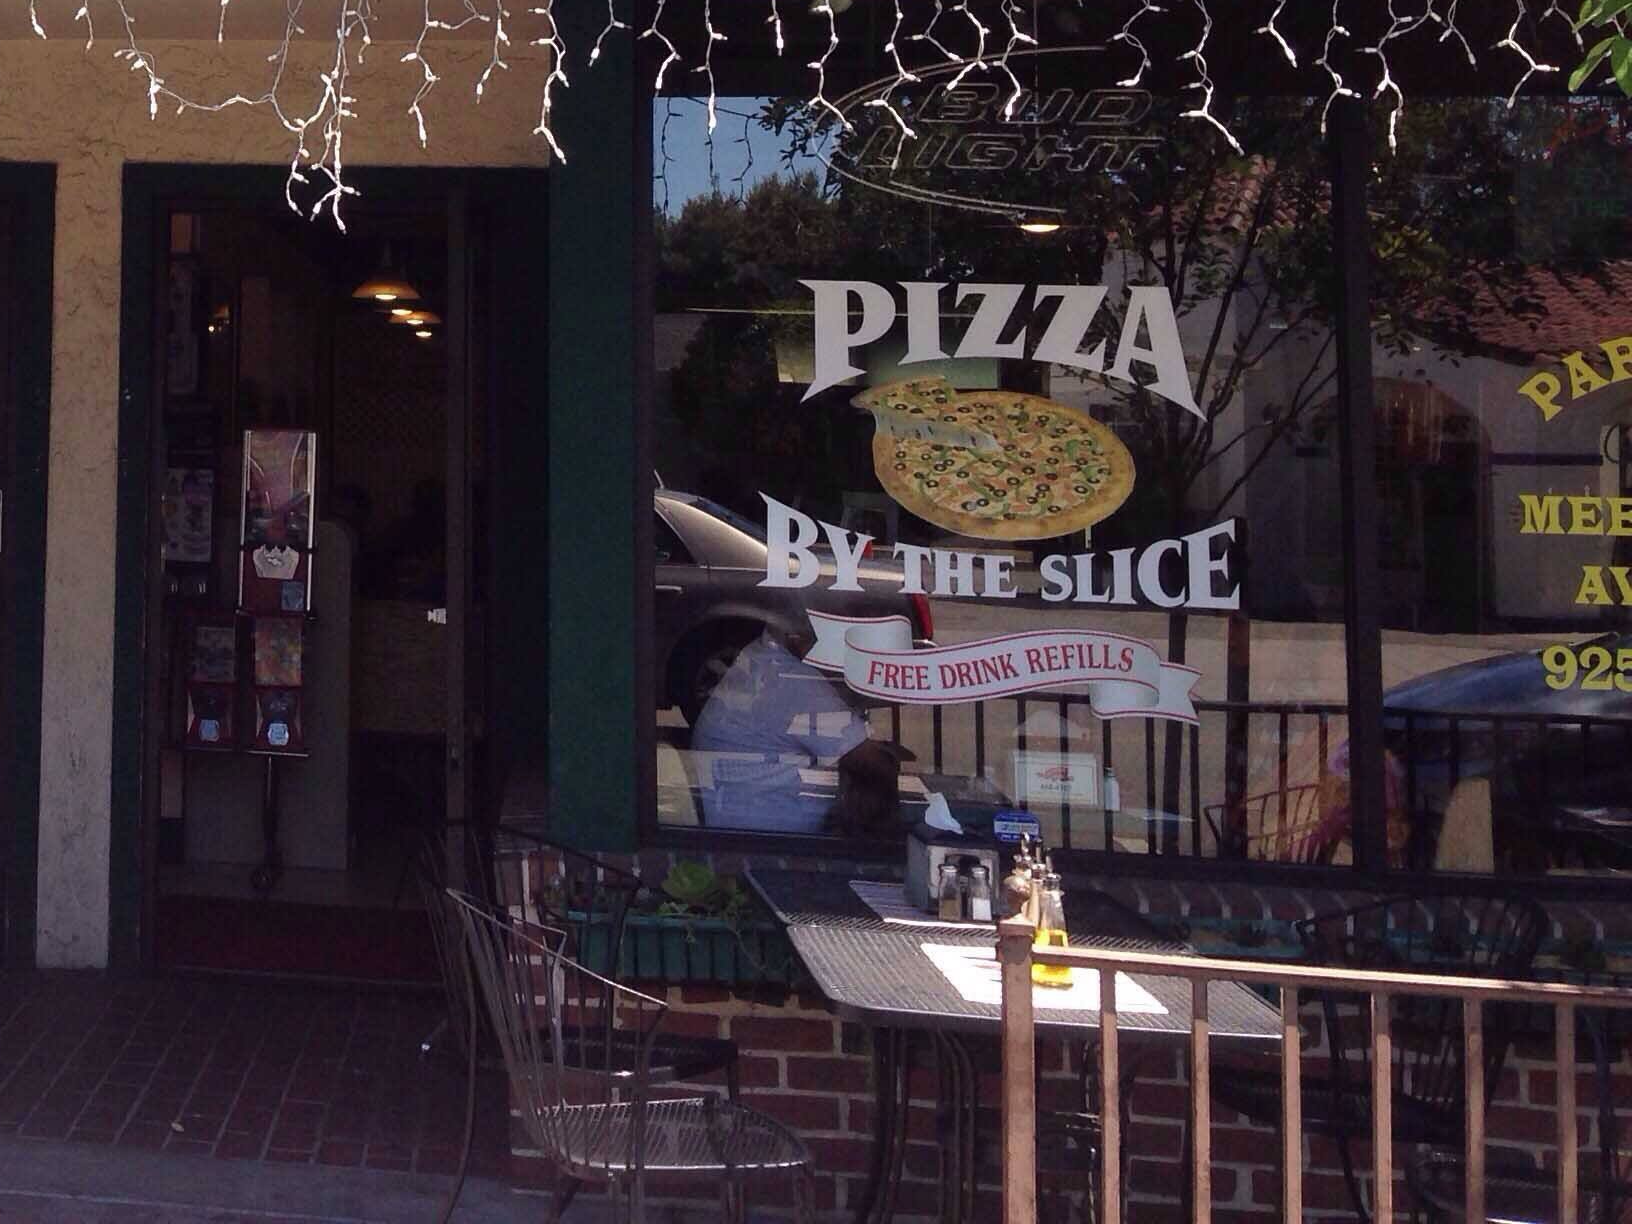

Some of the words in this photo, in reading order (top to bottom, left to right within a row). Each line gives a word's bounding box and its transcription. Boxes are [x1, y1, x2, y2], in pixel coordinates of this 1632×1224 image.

[916, 82, 1153, 127] BUD
[858, 125, 1166, 172] LIGHT
[797, 279, 1207, 422] PIZZA
[756, 491, 876, 592] BY
[893, 542, 1018, 599] THE
[1040, 519, 1242, 610] SLICE
[867, 661, 929, 691] FREE
[939, 653, 1019, 690] DRINK
[1025, 644, 1135, 675] REFILLS
